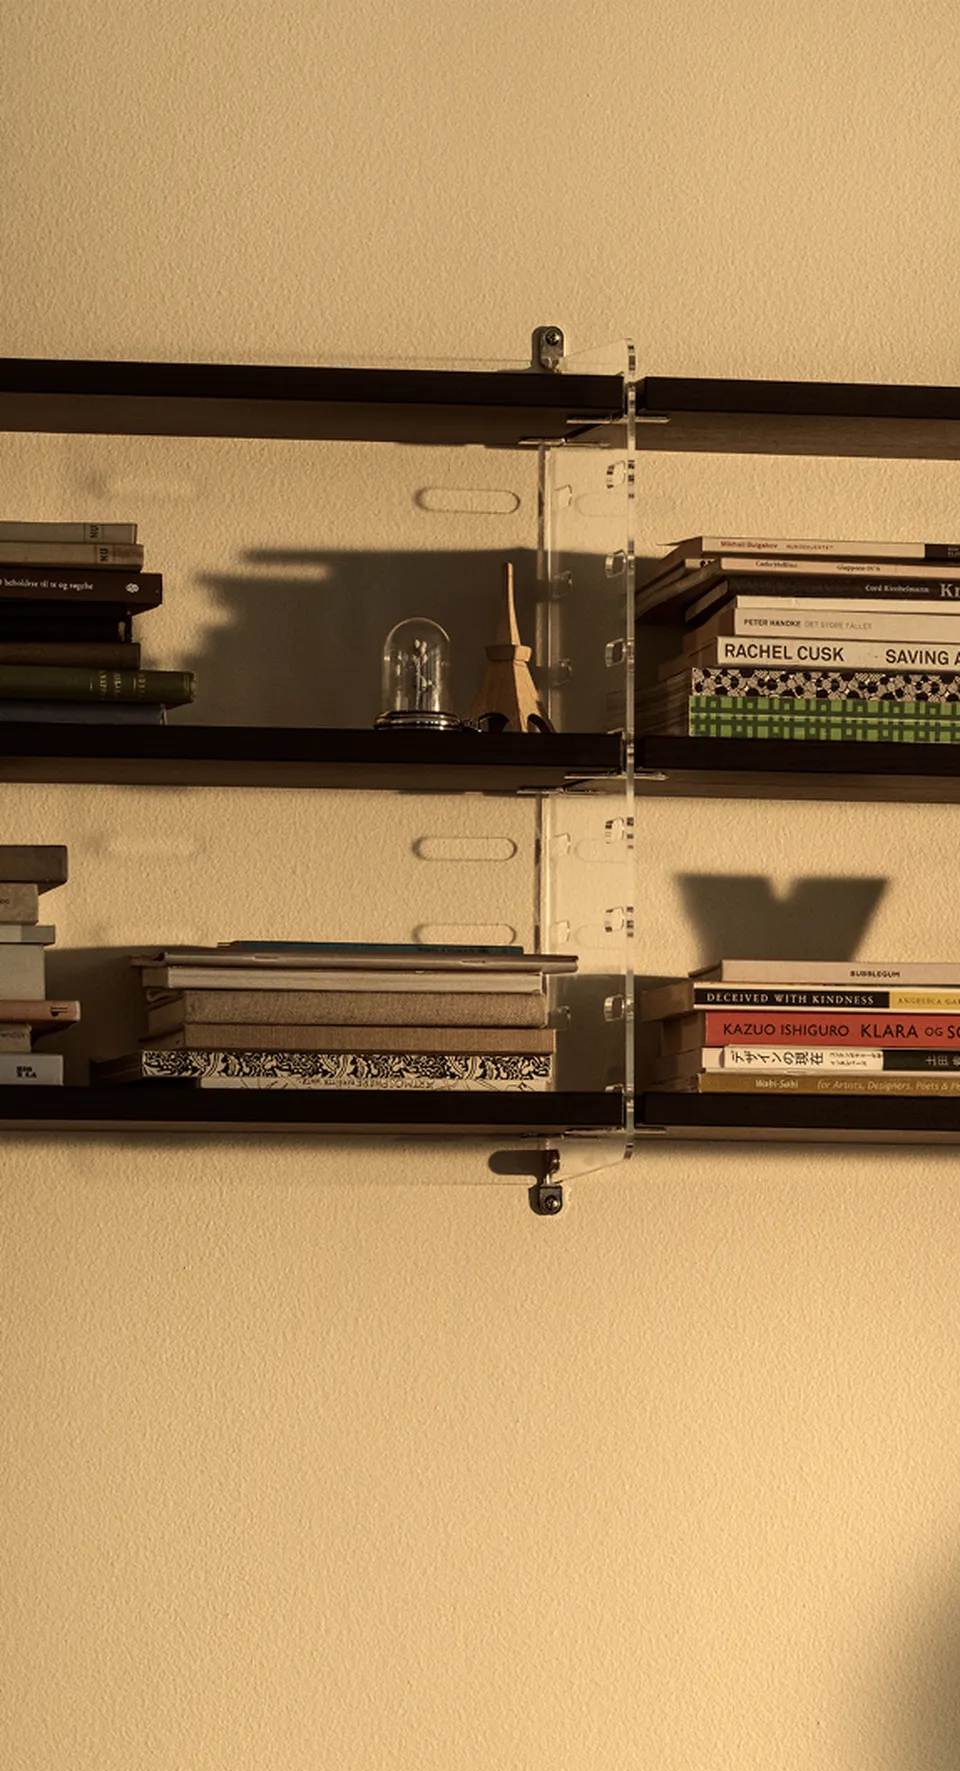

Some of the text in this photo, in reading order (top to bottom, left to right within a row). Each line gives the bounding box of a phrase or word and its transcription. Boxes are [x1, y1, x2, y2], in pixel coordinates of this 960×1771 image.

[865, 584, 882, 592] Cord
[744, 618, 769, 627] PETER
[769, 619, 801, 629] HANDKE
[724, 642, 793, 662] RACHEL
[796, 644, 844, 663] CUSK
[885, 647, 949, 667] SAVING
[850, 970, 901, 979] BUBBLEGUM
[706, 991, 771, 1004] DECEIVED
[774, 993, 808, 1005] WITH
[811, 993, 875, 1006] KINDNESS
[897, 996, 942, 1006] ANGELICA
[722, 1023, 775, 1036] KAZUO
[780, 1024, 850, 1038] ISHIGURO
[860, 1025, 918, 1040] KLARA
[924, 1027, 943, 1038] OG
[730, 1050, 824, 1066] デザインの現在
[755, 1078, 799, 1089] Wabi-Sabi
[816, 1079, 829, 1091] for
[832, 1081, 865, 1092] Artists,
[867, 1081, 913, 1093] Designers,
[915, 1081, 940, 1092] Poets
[940, 1082, 949, 1092] &
